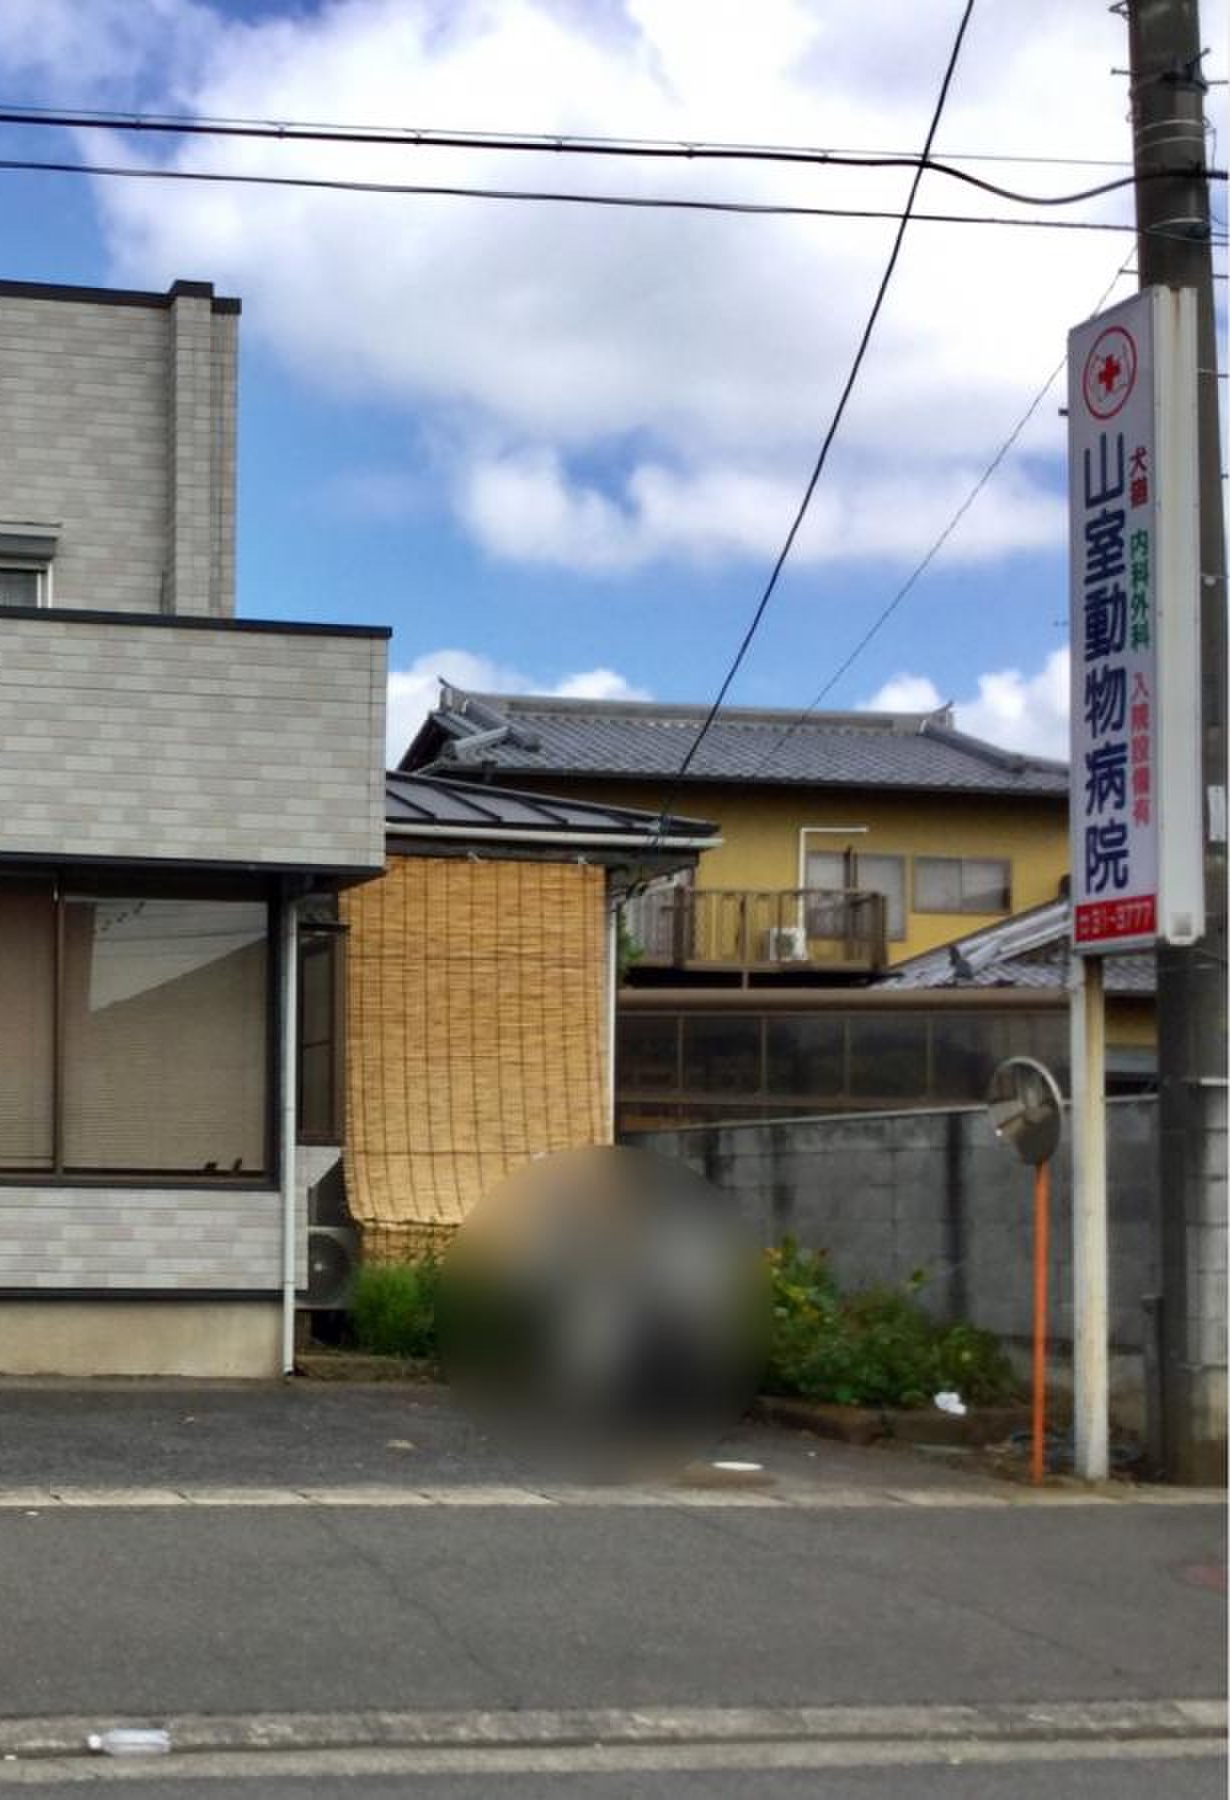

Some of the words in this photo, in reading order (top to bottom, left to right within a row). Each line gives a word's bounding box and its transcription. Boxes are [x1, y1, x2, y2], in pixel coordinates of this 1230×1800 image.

[1083, 431, 1129, 894] 山室動物病院
[1130, 528, 1150, 653] 内科外科
[1130, 671, 1151, 827] 入院設備有
